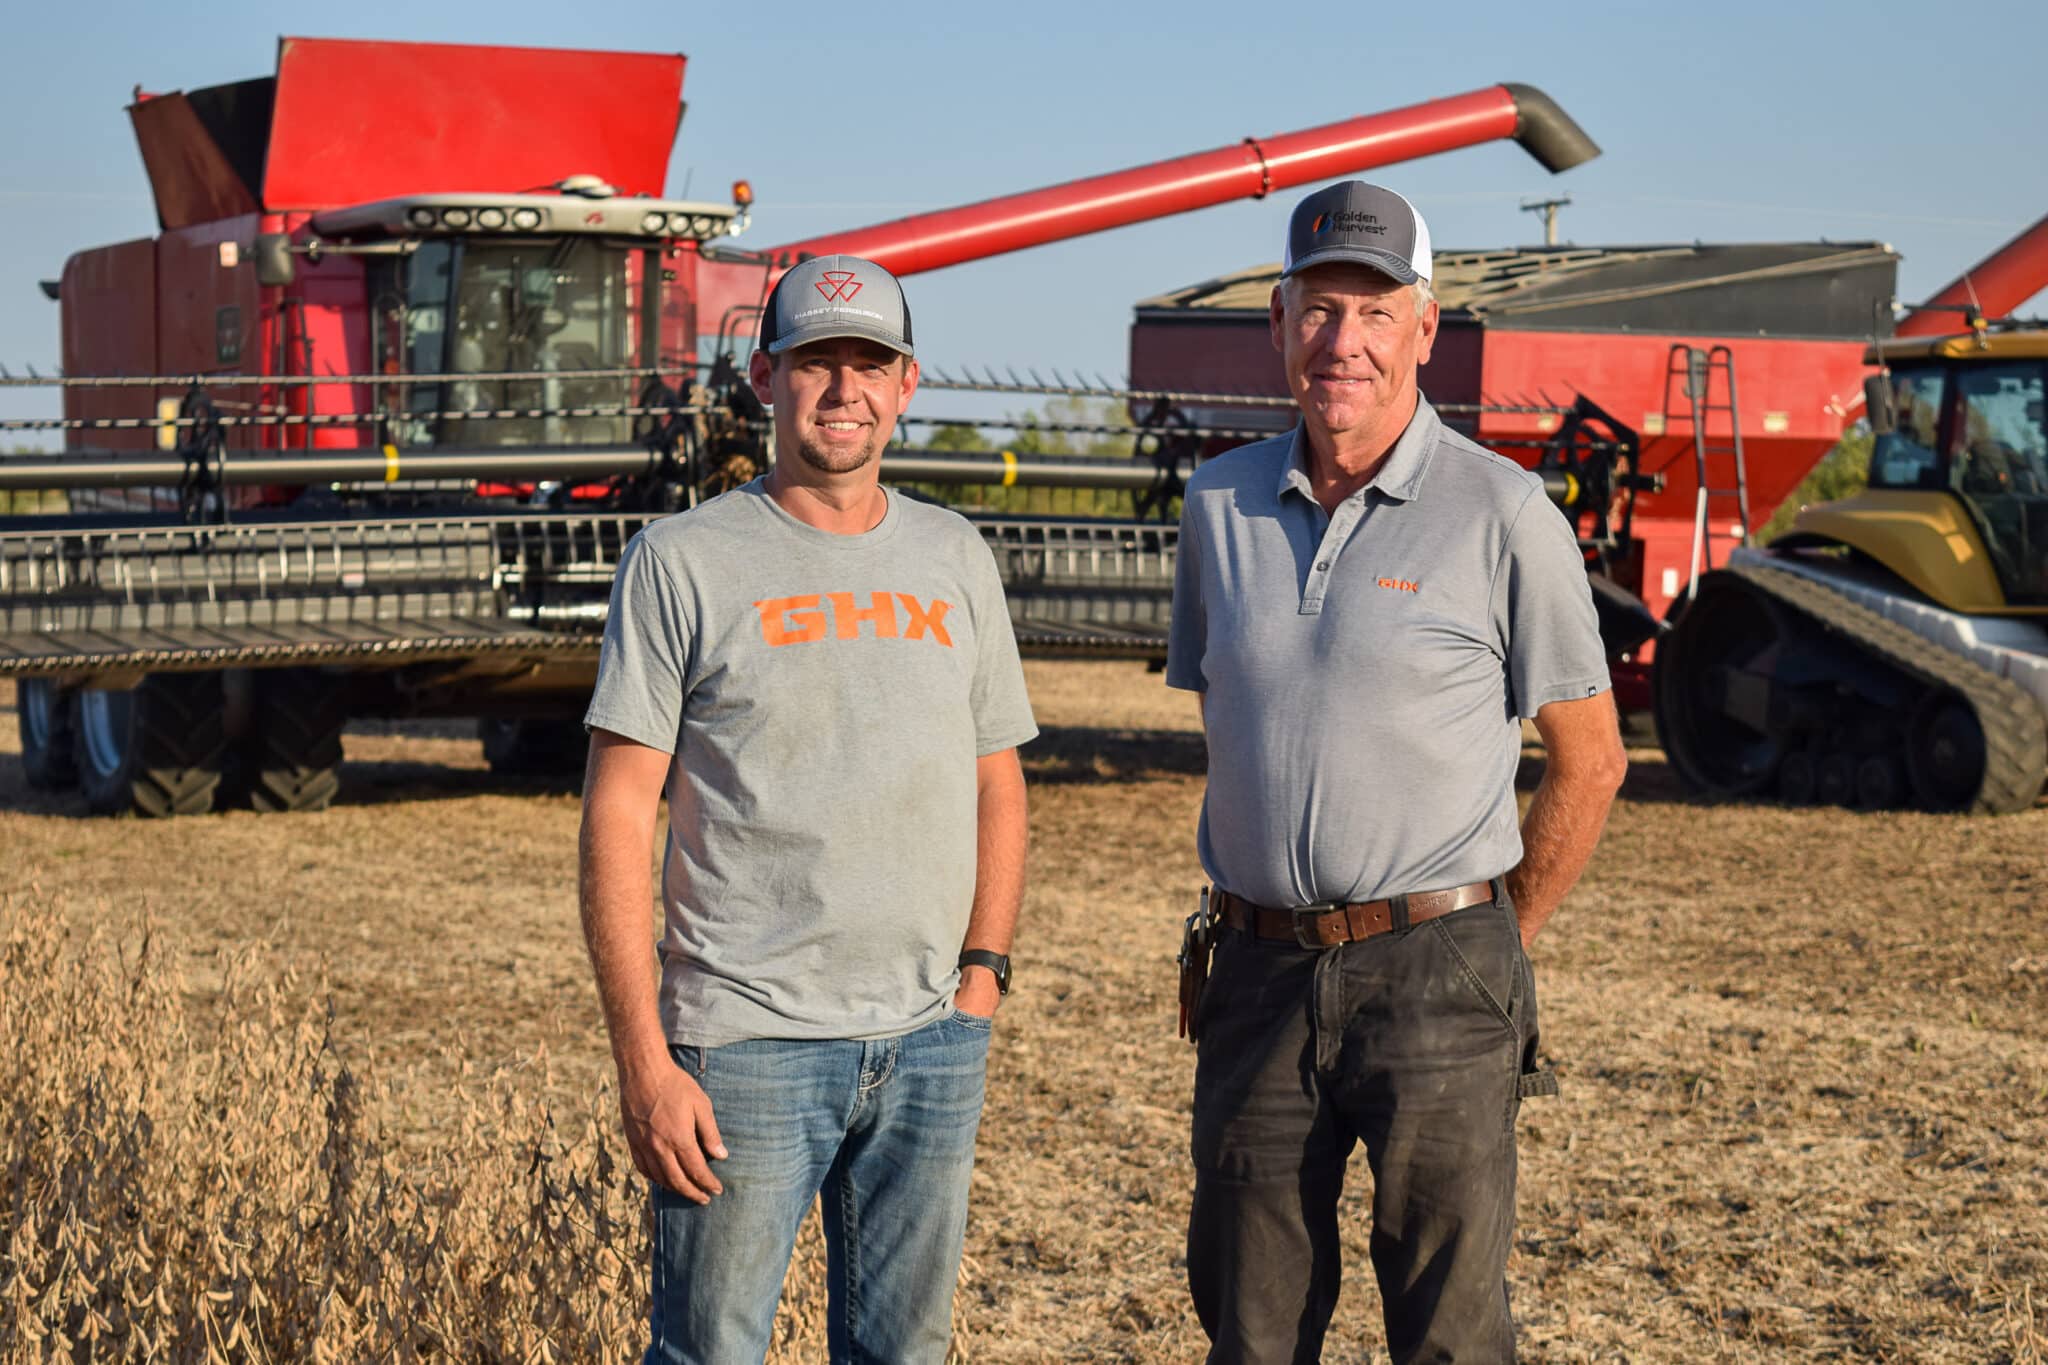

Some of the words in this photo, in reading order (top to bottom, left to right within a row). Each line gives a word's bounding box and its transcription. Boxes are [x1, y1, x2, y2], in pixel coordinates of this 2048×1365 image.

[1333, 210, 1377, 224] Golden
[1332, 222, 1387, 235] Harvest
[792, 307, 831, 320] MASSEY
[752, 591, 955, 648] GHX
